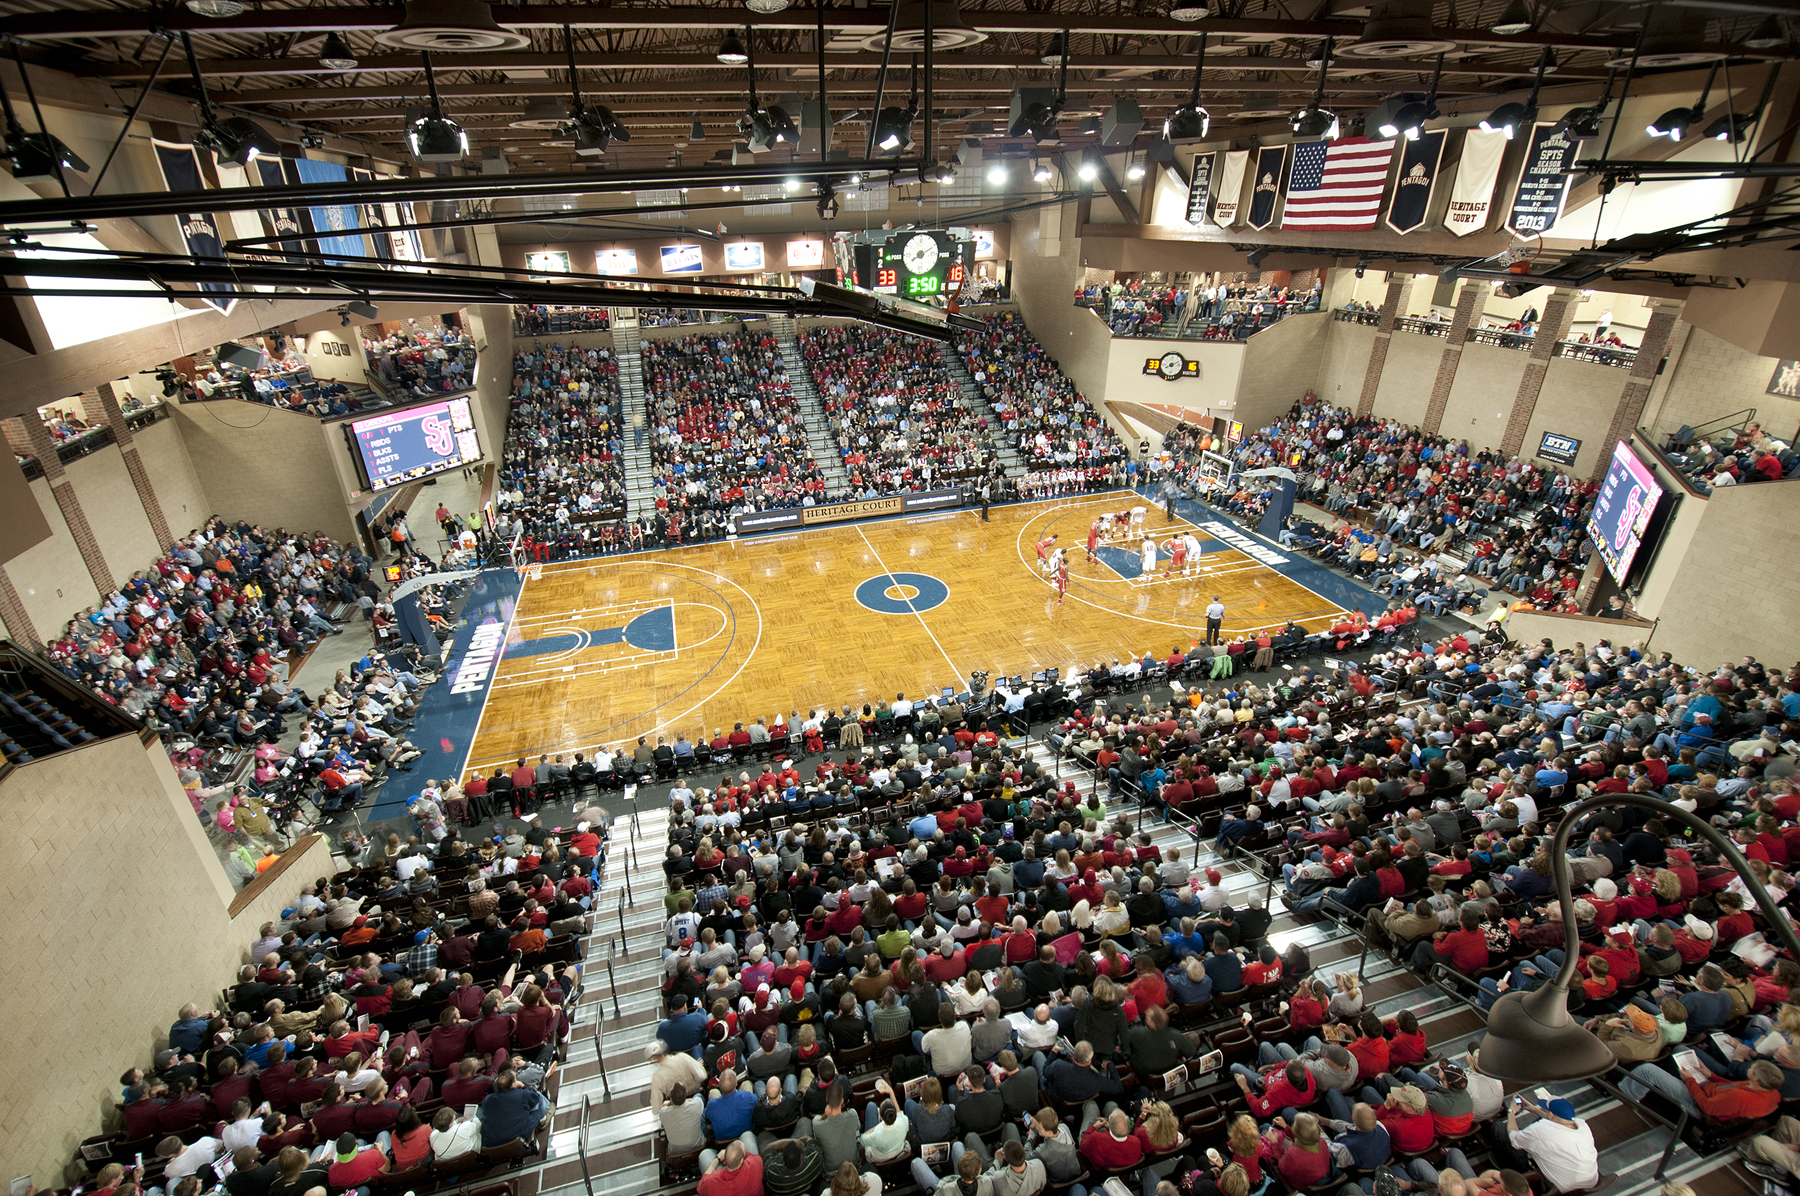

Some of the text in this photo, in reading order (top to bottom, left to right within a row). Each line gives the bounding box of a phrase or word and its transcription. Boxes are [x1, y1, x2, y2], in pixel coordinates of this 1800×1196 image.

[1540, 141, 1571, 149] PENTAGON
[1540, 150, 1564, 160] SPTS
[1451, 201, 1487, 211] HERITAGE
[1453, 213, 1477, 222] COURT
[1515, 215, 1546, 230] 2013
[183, 220, 215, 239] PNTAGON
[878, 248, 884, 257] 1
[878, 259, 884, 268] 2
[879, 270, 896, 286] 33
[950, 266, 963, 281] 16
[909, 276, 938, 292] 3:50
[1148, 360, 1160, 370] 33
[1188, 362, 1196, 371] 16
[388, 424, 402, 434] PTS
[370, 438, 392, 448] RBDS
[1545, 436, 1573, 450] BTN
[372, 447, 392, 458] BLKS
[376, 454, 400, 466] ASSTS
[378, 464, 392, 474] FLS
[806, 504, 859, 518] HERITAGE
[862, 500, 898, 511] COURT
[1198, 521, 1290, 566] PENTAGON
[450, 622, 505, 694] PENTAGON
[678, 928, 688, 940] 8
